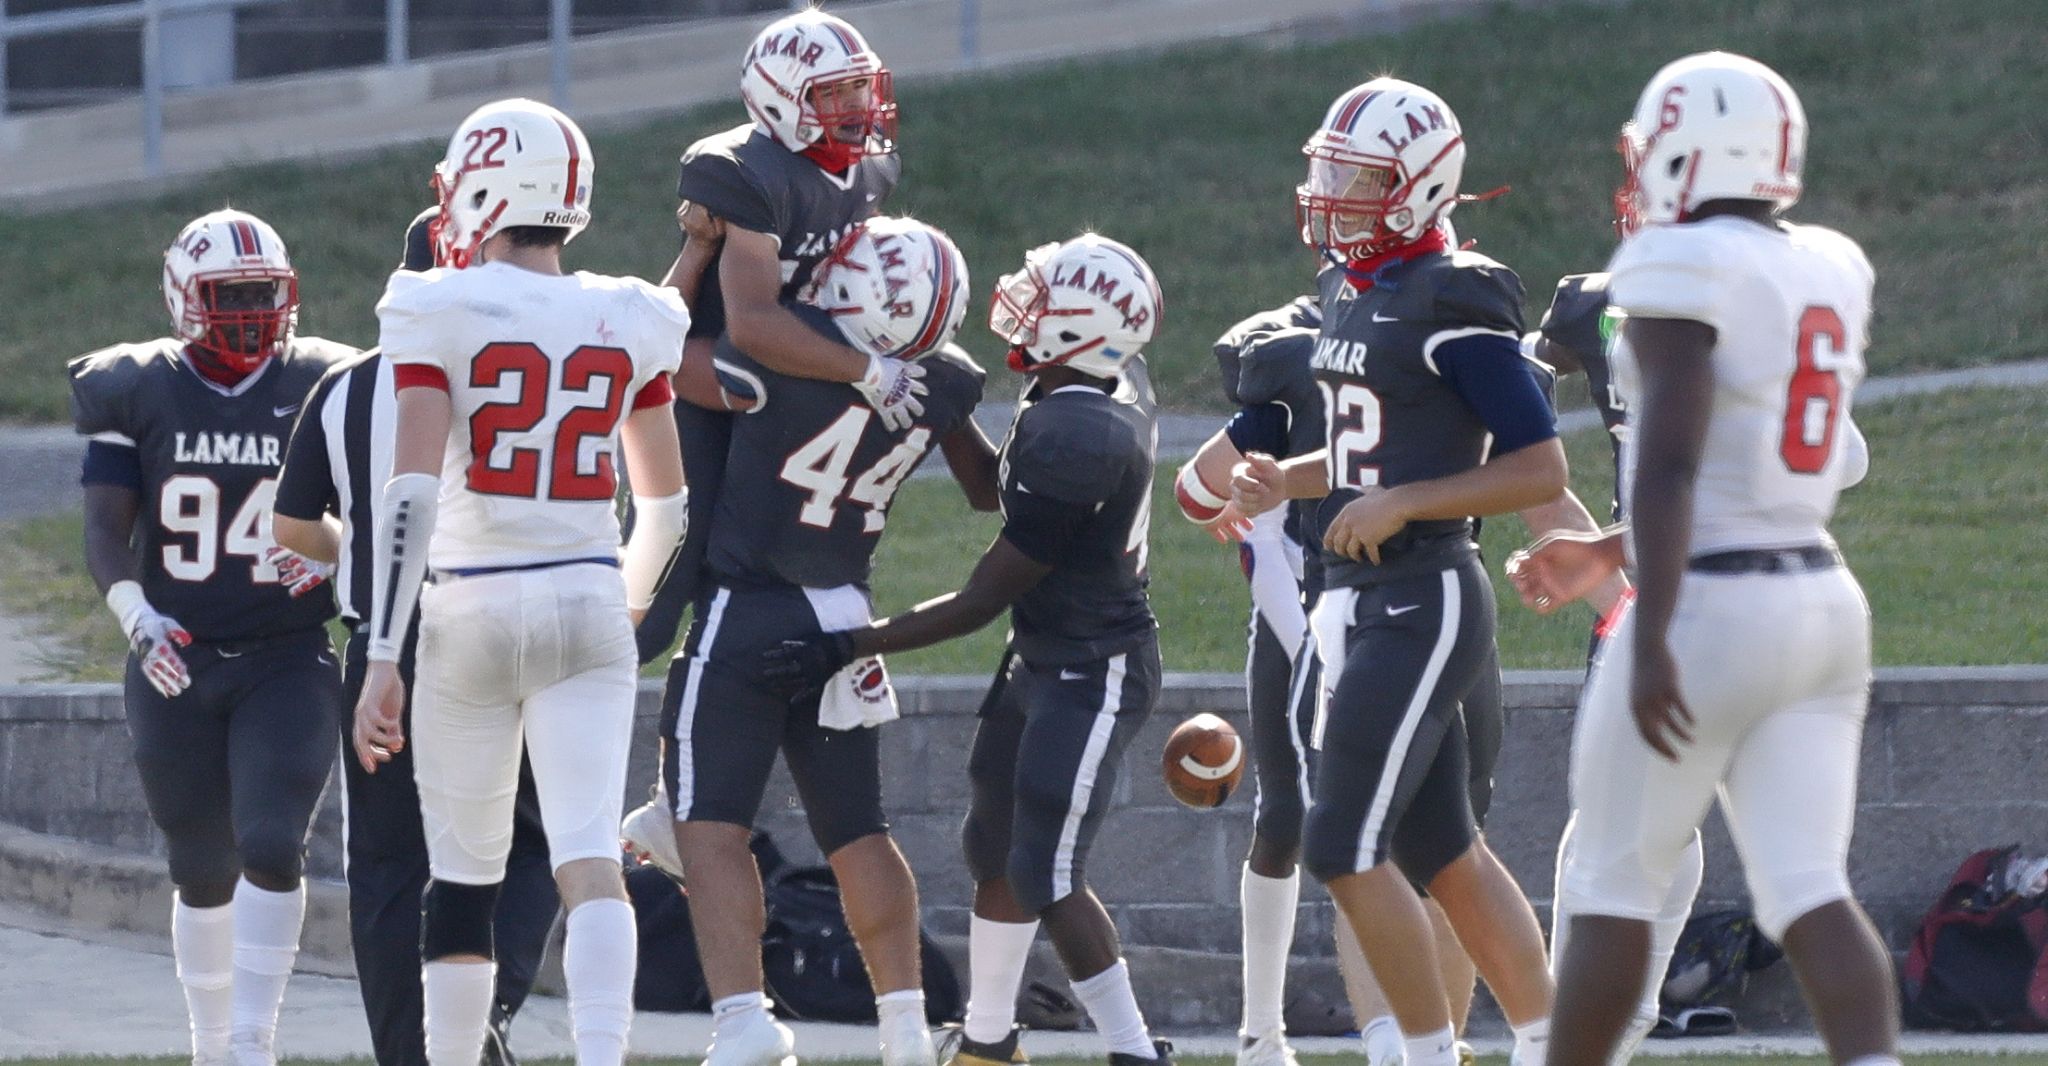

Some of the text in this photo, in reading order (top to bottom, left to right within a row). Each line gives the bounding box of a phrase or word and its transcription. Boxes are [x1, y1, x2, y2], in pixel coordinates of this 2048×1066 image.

[463, 127, 508, 172] 22
[1661, 85, 1687, 131] 6
[1051, 264, 1149, 332] LAMAR
[465, 341, 634, 501] 22
[1779, 305, 1845, 474] 6
[174, 431, 280, 466] LAMAR
[778, 404, 933, 533] 44
[160, 474, 282, 583] 94
